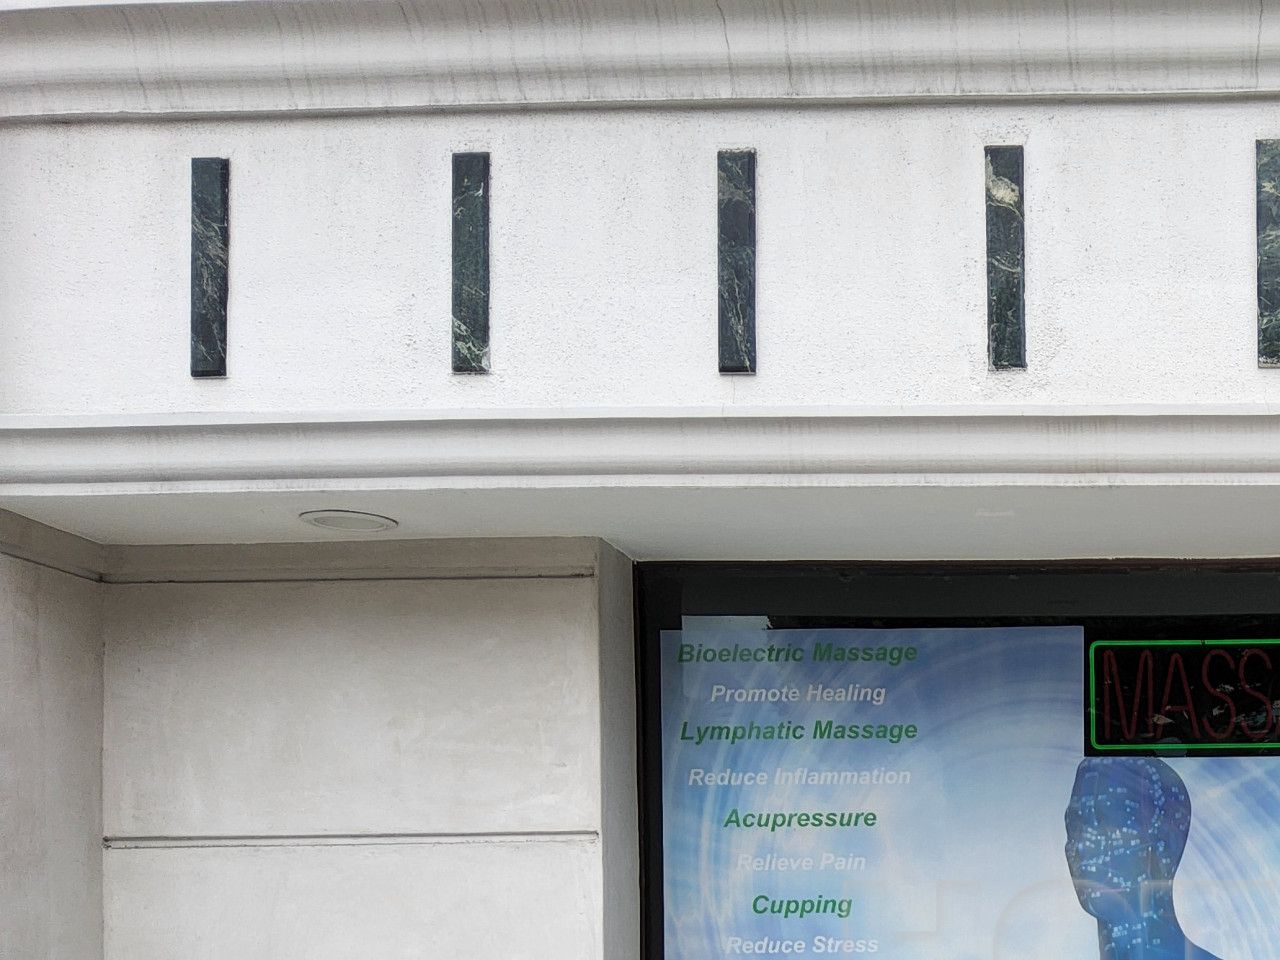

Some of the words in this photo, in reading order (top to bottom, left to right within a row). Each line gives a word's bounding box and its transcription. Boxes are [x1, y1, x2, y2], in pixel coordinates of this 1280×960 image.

[677, 644, 804, 663] Bioelectric
[812, 643, 918, 666] Massage
[711, 685, 800, 702] Promote
[806, 684, 886, 705] Healing
[681, 722, 804, 745] Lymphatic
[812, 721, 918, 744] Massage
[688, 769, 768, 786] Reduce
[774, 768, 911, 785] Inflammation
[723, 809, 877, 832] Acupressure
[736, 853, 814, 871] Relieve
[819, 852, 866, 870] Pain
[752, 895, 852, 918] Cupping
[726, 937, 806, 954] Reduce
[812, 936, 879, 953] Stress
